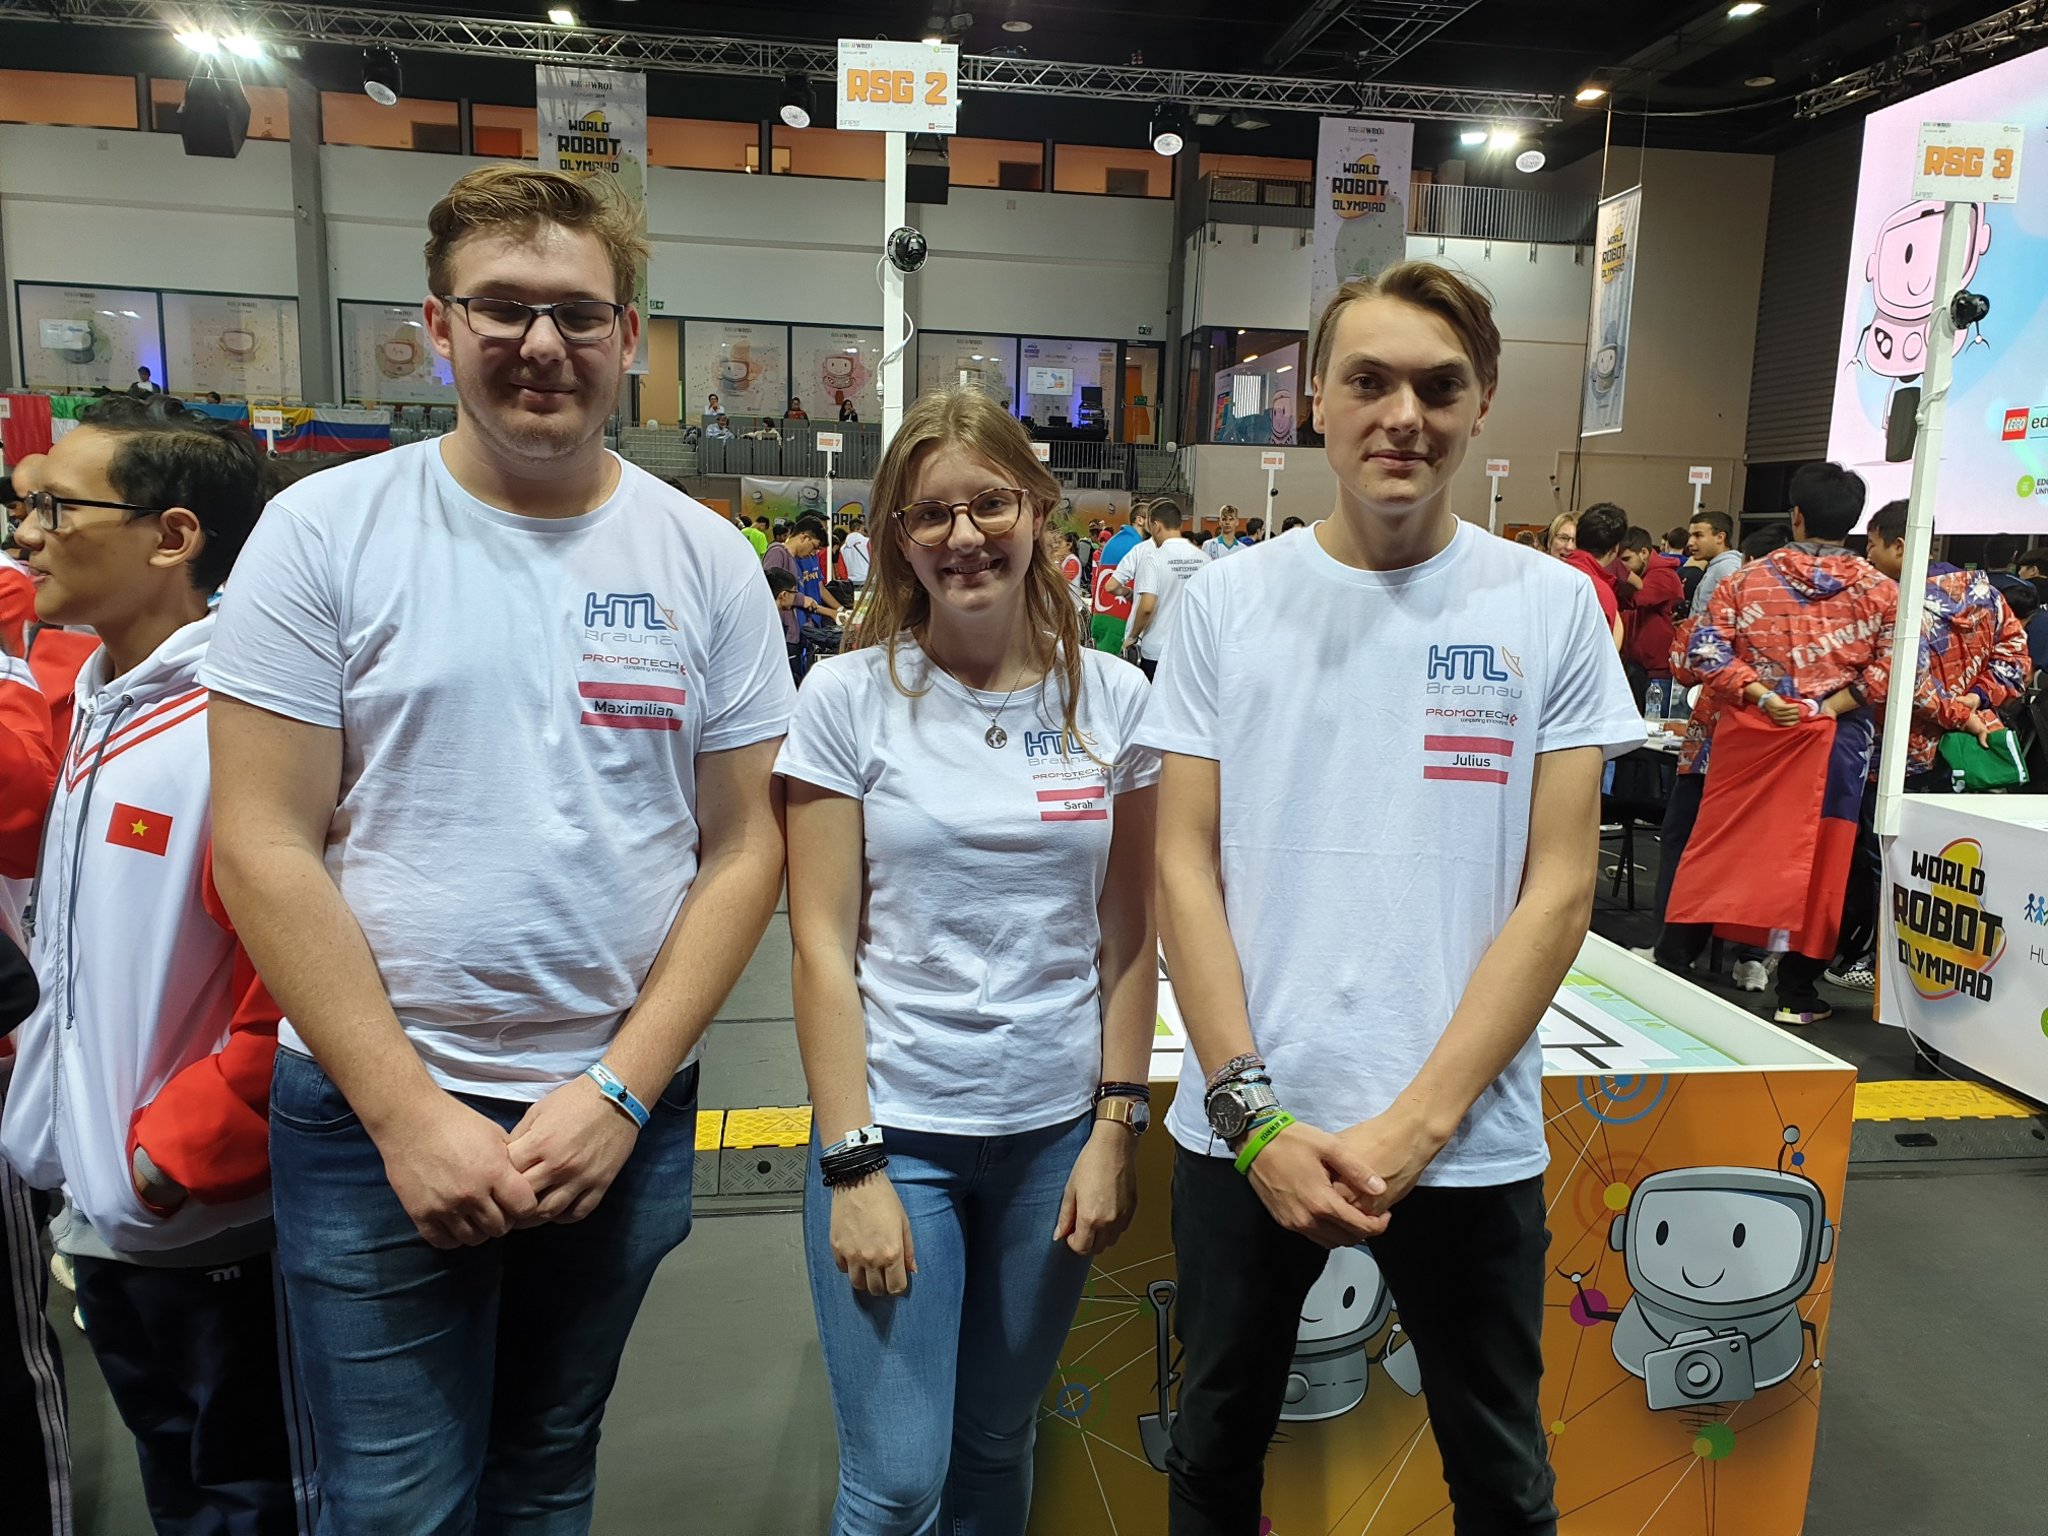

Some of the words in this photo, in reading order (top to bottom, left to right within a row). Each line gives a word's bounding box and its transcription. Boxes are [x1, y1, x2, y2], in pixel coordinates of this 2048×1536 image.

[847, 68, 914, 104] RSG
[925, 71, 947, 105] 2
[569, 120, 609, 132] WORLD
[557, 135, 621, 155] ROBOT
[1343, 162, 1380, 175] WORLD
[1923, 145, 1985, 177] RSG
[1992, 148, 2014, 178] 3
[1332, 177, 1388, 196] ROBOT
[1333, 200, 1386, 213] OLYMPIAD
[1602, 243, 1627, 265] ROBOT
[584, 592, 668, 631] HTL
[584, 628, 678, 647] Brauna
[582, 653, 680, 669] PROMOTECH
[1427, 644, 1509, 682] HTL
[1426, 682, 1523, 699] Braunau
[594, 700, 674, 717] Maximilian
[1425, 708, 1510, 721] PROMOTECH
[1452, 753, 1491, 767] Julius
[1032, 767, 1100, 780] PROMOTECH
[1064, 800, 1093, 810] Sarah
[1911, 850, 1986, 896] WORLD
[1893, 882, 2003, 956] ROBOT
[1898, 938, 1993, 1002] OLYMPIAD
